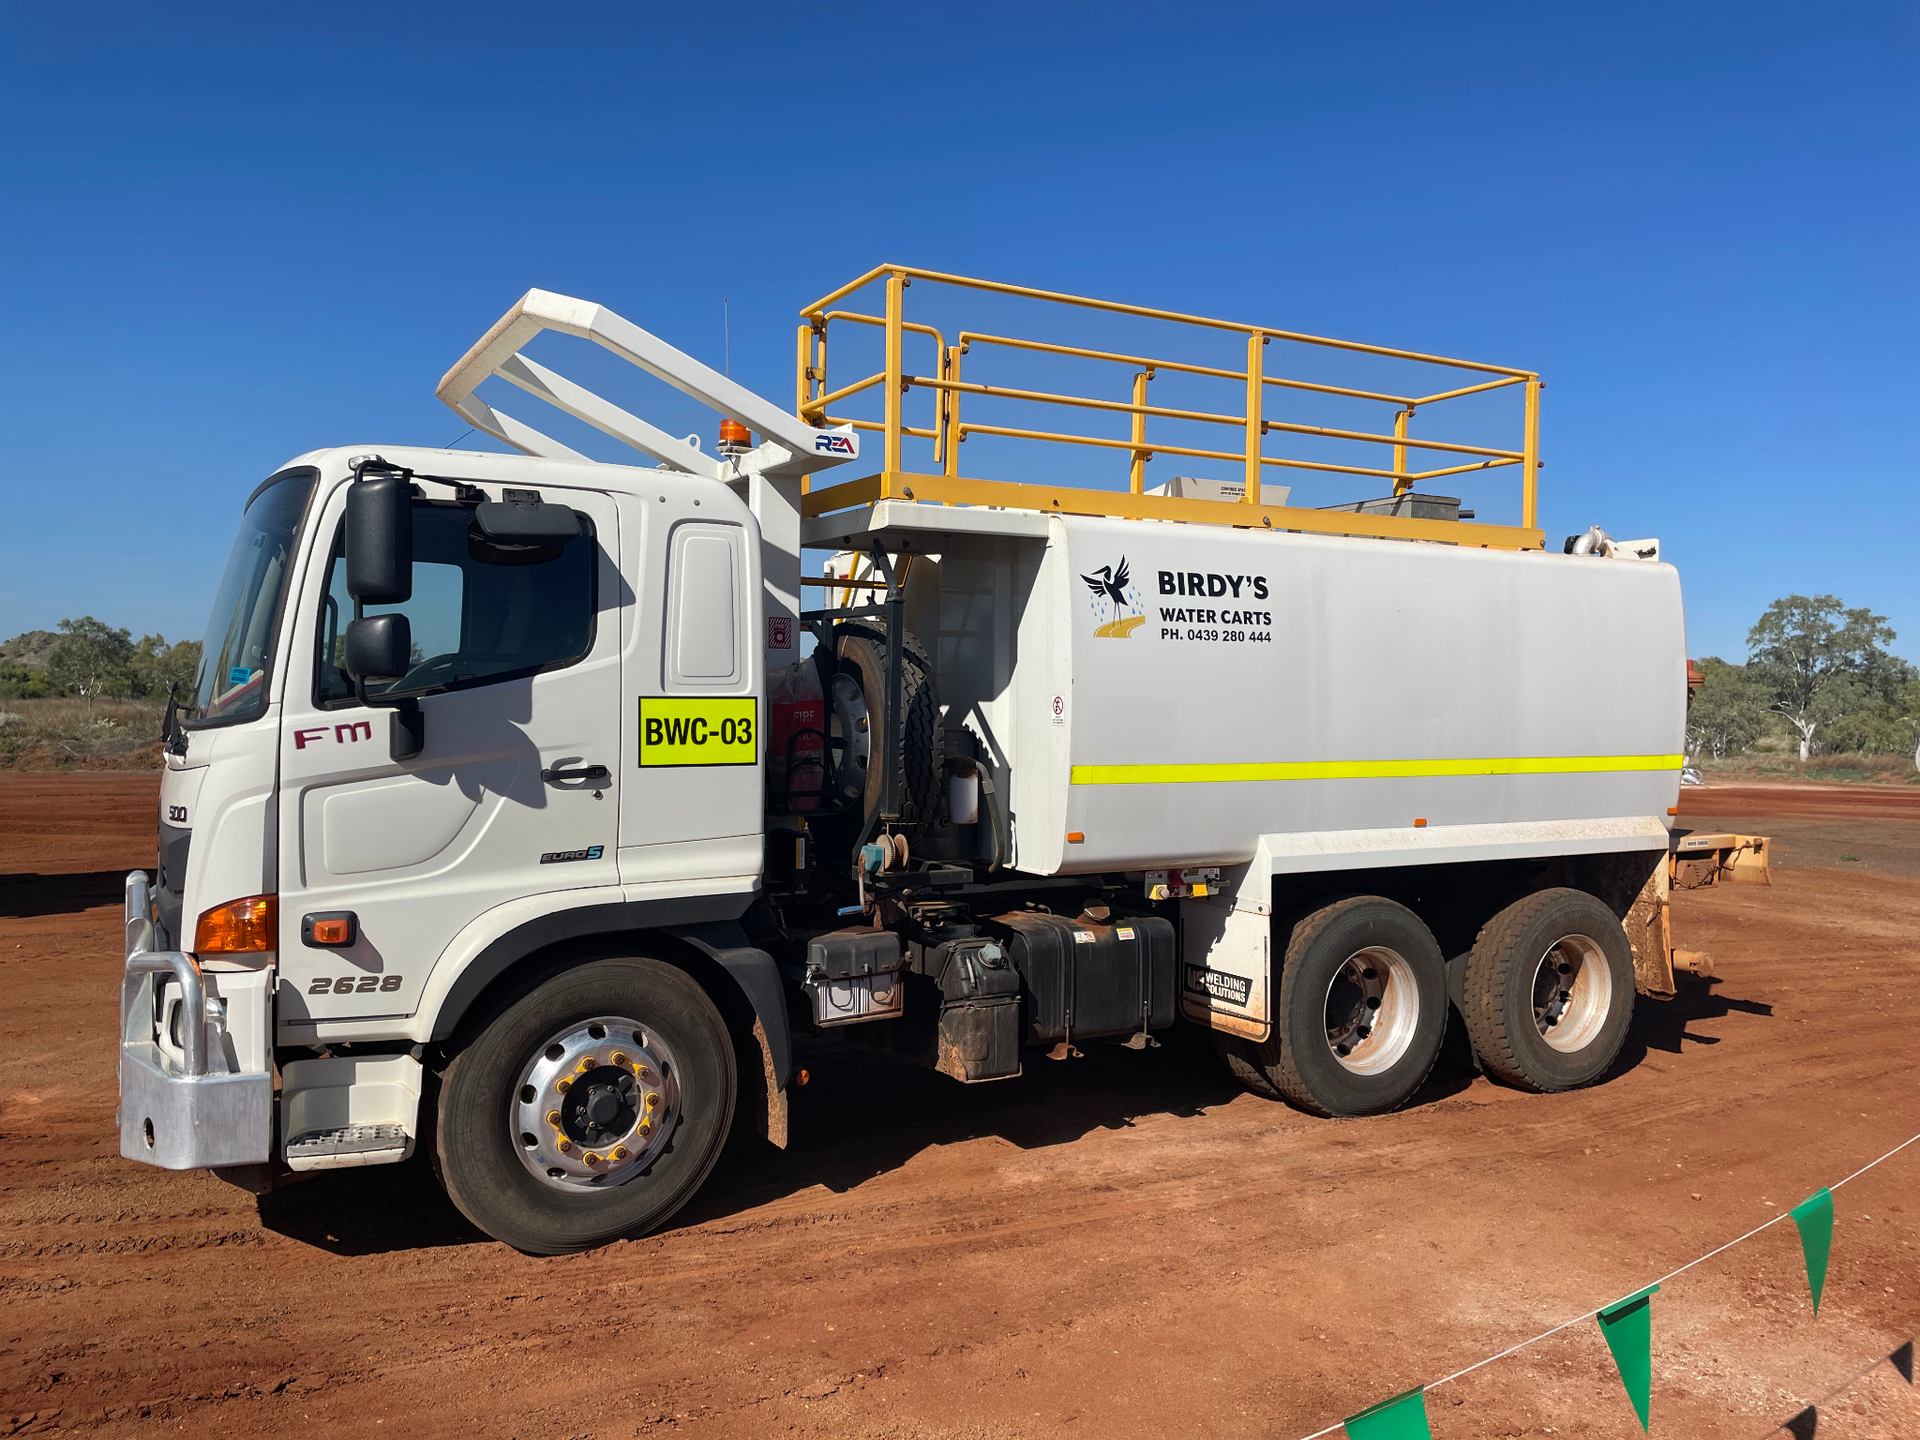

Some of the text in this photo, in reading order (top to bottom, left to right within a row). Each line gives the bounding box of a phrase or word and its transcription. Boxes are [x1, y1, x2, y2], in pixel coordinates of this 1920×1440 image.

[815, 434, 856, 455] REA
[1157, 570, 1269, 600] BIRDY'S
[1159, 607, 1272, 626] WATER CARTS
[1161, 628, 1272, 643] PH. 0439 280 444
[793, 710, 815, 723] FIRE
[645, 717, 753, 746] BWC-03
[308, 975, 403, 995] 2628
[1205, 972, 1246, 992] WELDING
[1205, 983, 1246, 1003] SOLUTIONS
[486, 988, 590, 1081] TOYO
